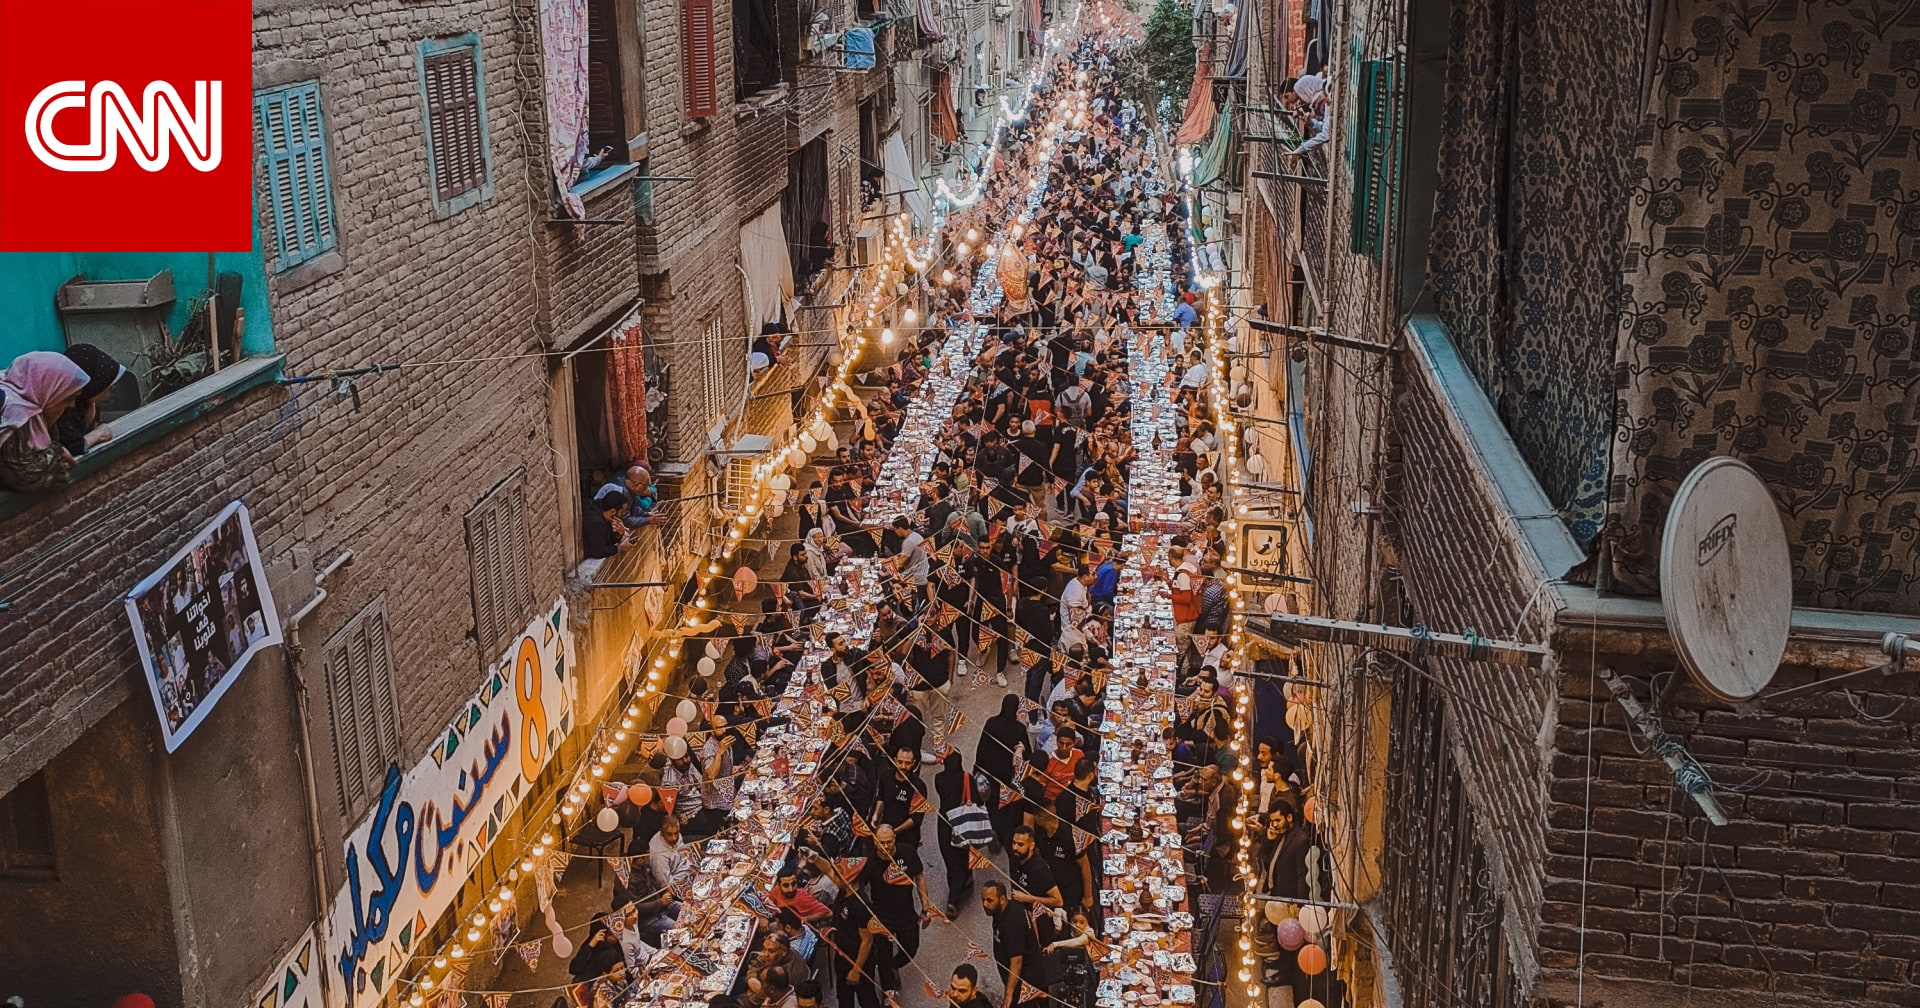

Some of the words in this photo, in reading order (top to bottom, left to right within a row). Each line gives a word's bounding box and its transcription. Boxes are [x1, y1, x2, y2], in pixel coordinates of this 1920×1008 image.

[1698, 521, 1737, 558] PRIFIX
[186, 591, 211, 623] اخواتنا
[193, 621, 216, 651] قلوبنا
[515, 636, 547, 784] 8
[415, 709, 511, 893] سنين
